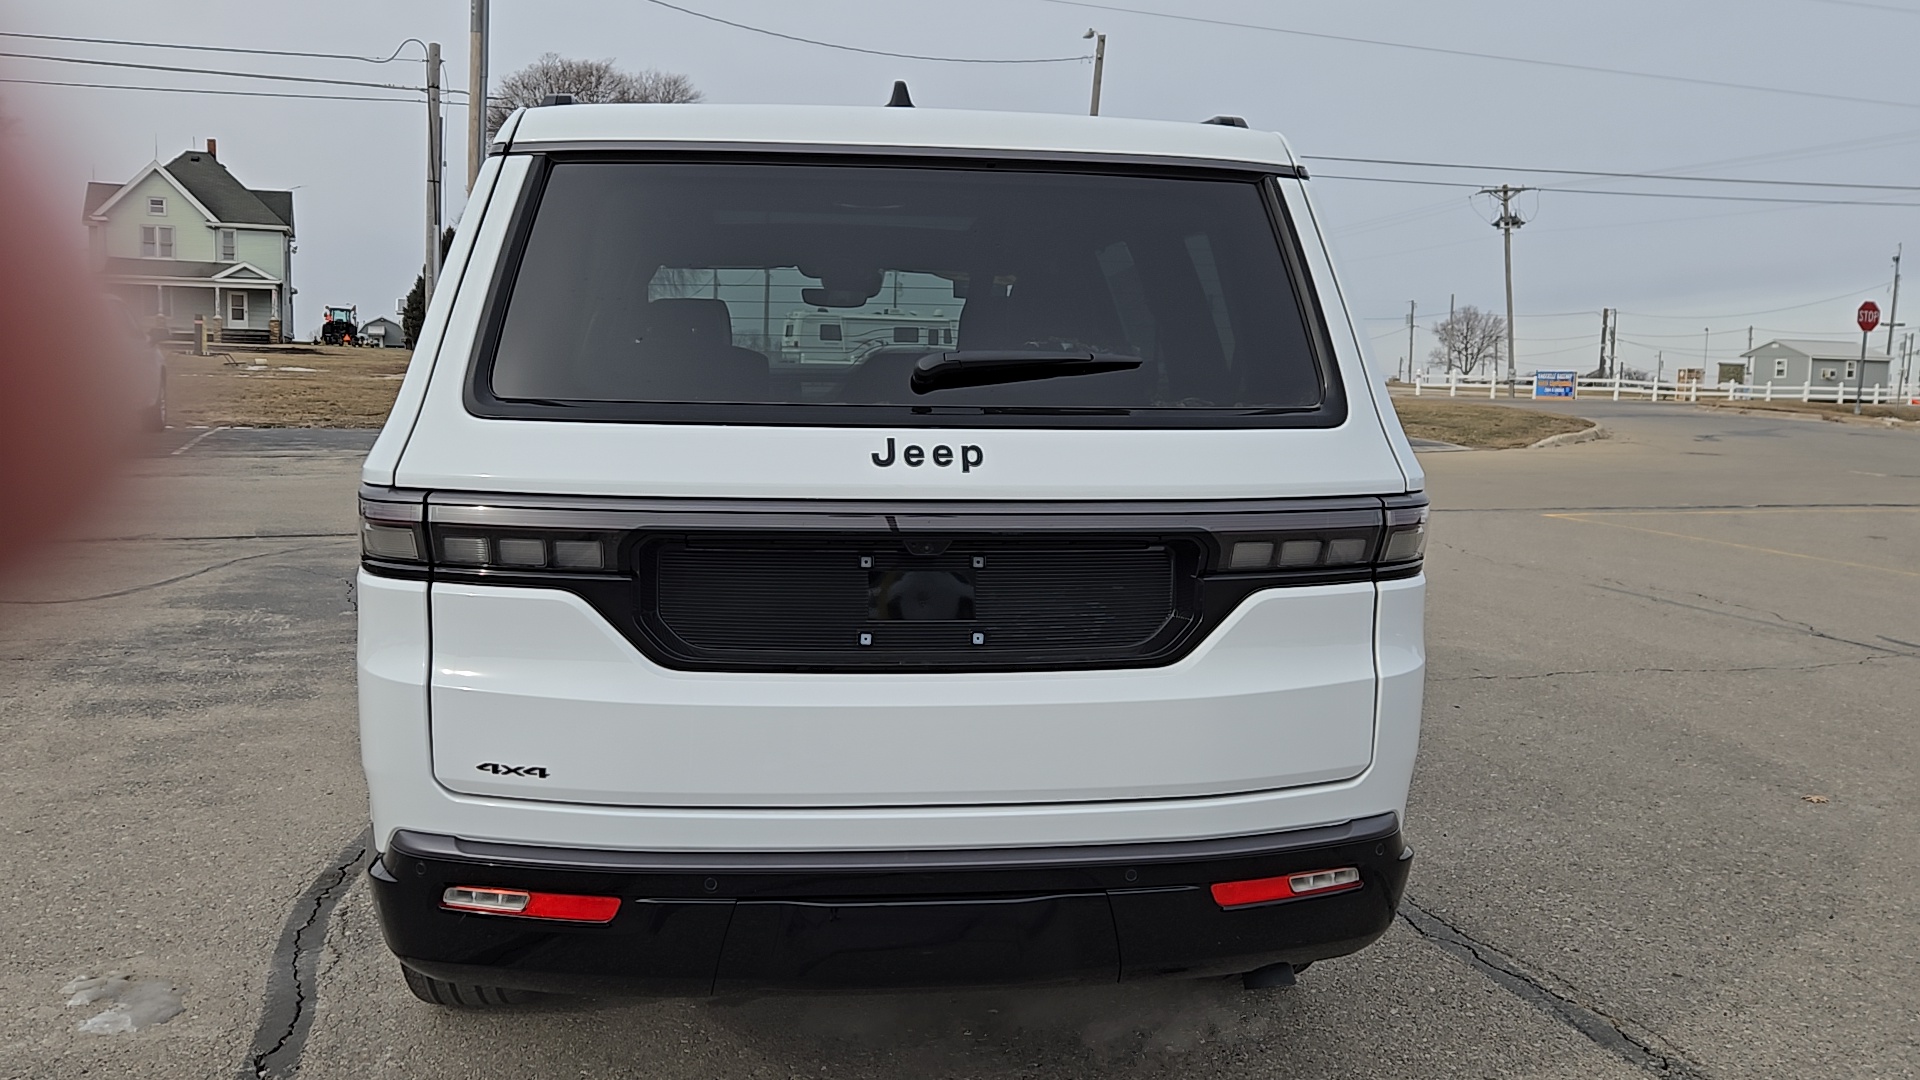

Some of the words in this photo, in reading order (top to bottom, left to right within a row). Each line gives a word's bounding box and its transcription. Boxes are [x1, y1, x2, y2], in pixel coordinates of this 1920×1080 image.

[1859, 310, 1880, 322] STOP
[871, 437, 984, 473] Jeep
[475, 762, 551, 779] 4x4
